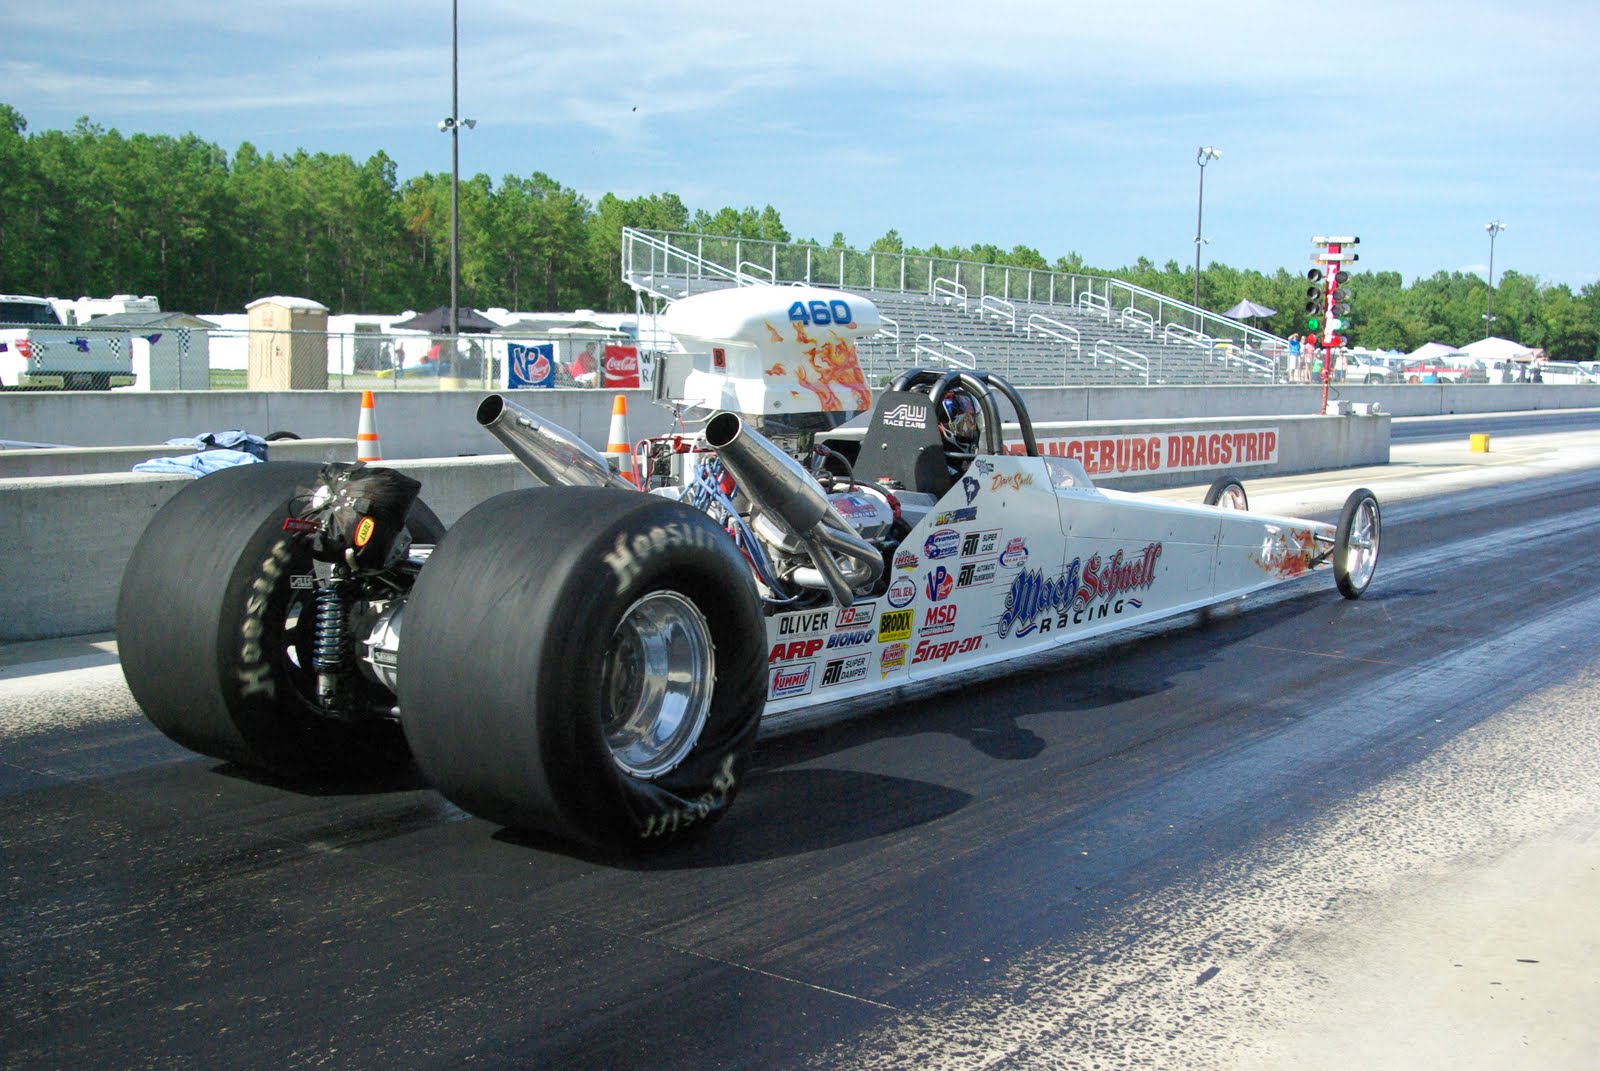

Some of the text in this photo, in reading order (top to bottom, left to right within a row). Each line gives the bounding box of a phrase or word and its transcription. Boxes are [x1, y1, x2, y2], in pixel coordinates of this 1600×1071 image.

[788, 299, 852, 325] 460
[883, 419, 926, 429] RACE CARS
[1002, 431, 1276, 474] GEBURG DRAGSTRIP
[961, 533, 980, 556] ATI
[982, 533, 997, 541] SUPER
[982, 543, 994, 552] CASE
[894, 555, 917, 565] IHRA
[927, 565, 947, 602] VP
[957, 564, 976, 587] ATI
[890, 586, 913, 599] TOTAL SEAL
[997, 541, 1163, 639] Mach Schnell
[780, 612, 829, 634] OLIVER
[880, 612, 912, 633] BRODIX
[924, 604, 957, 626] MSD
[826, 630, 873, 648] BIONDO
[911, 635, 983, 664] Snap-on
[768, 638, 824, 663] ARP
[822, 660, 844, 685] ATI
[840, 668, 866, 679] DAMPER
[845, 658, 865, 668] SUPER
[773, 668, 811, 694] SUMMIT
